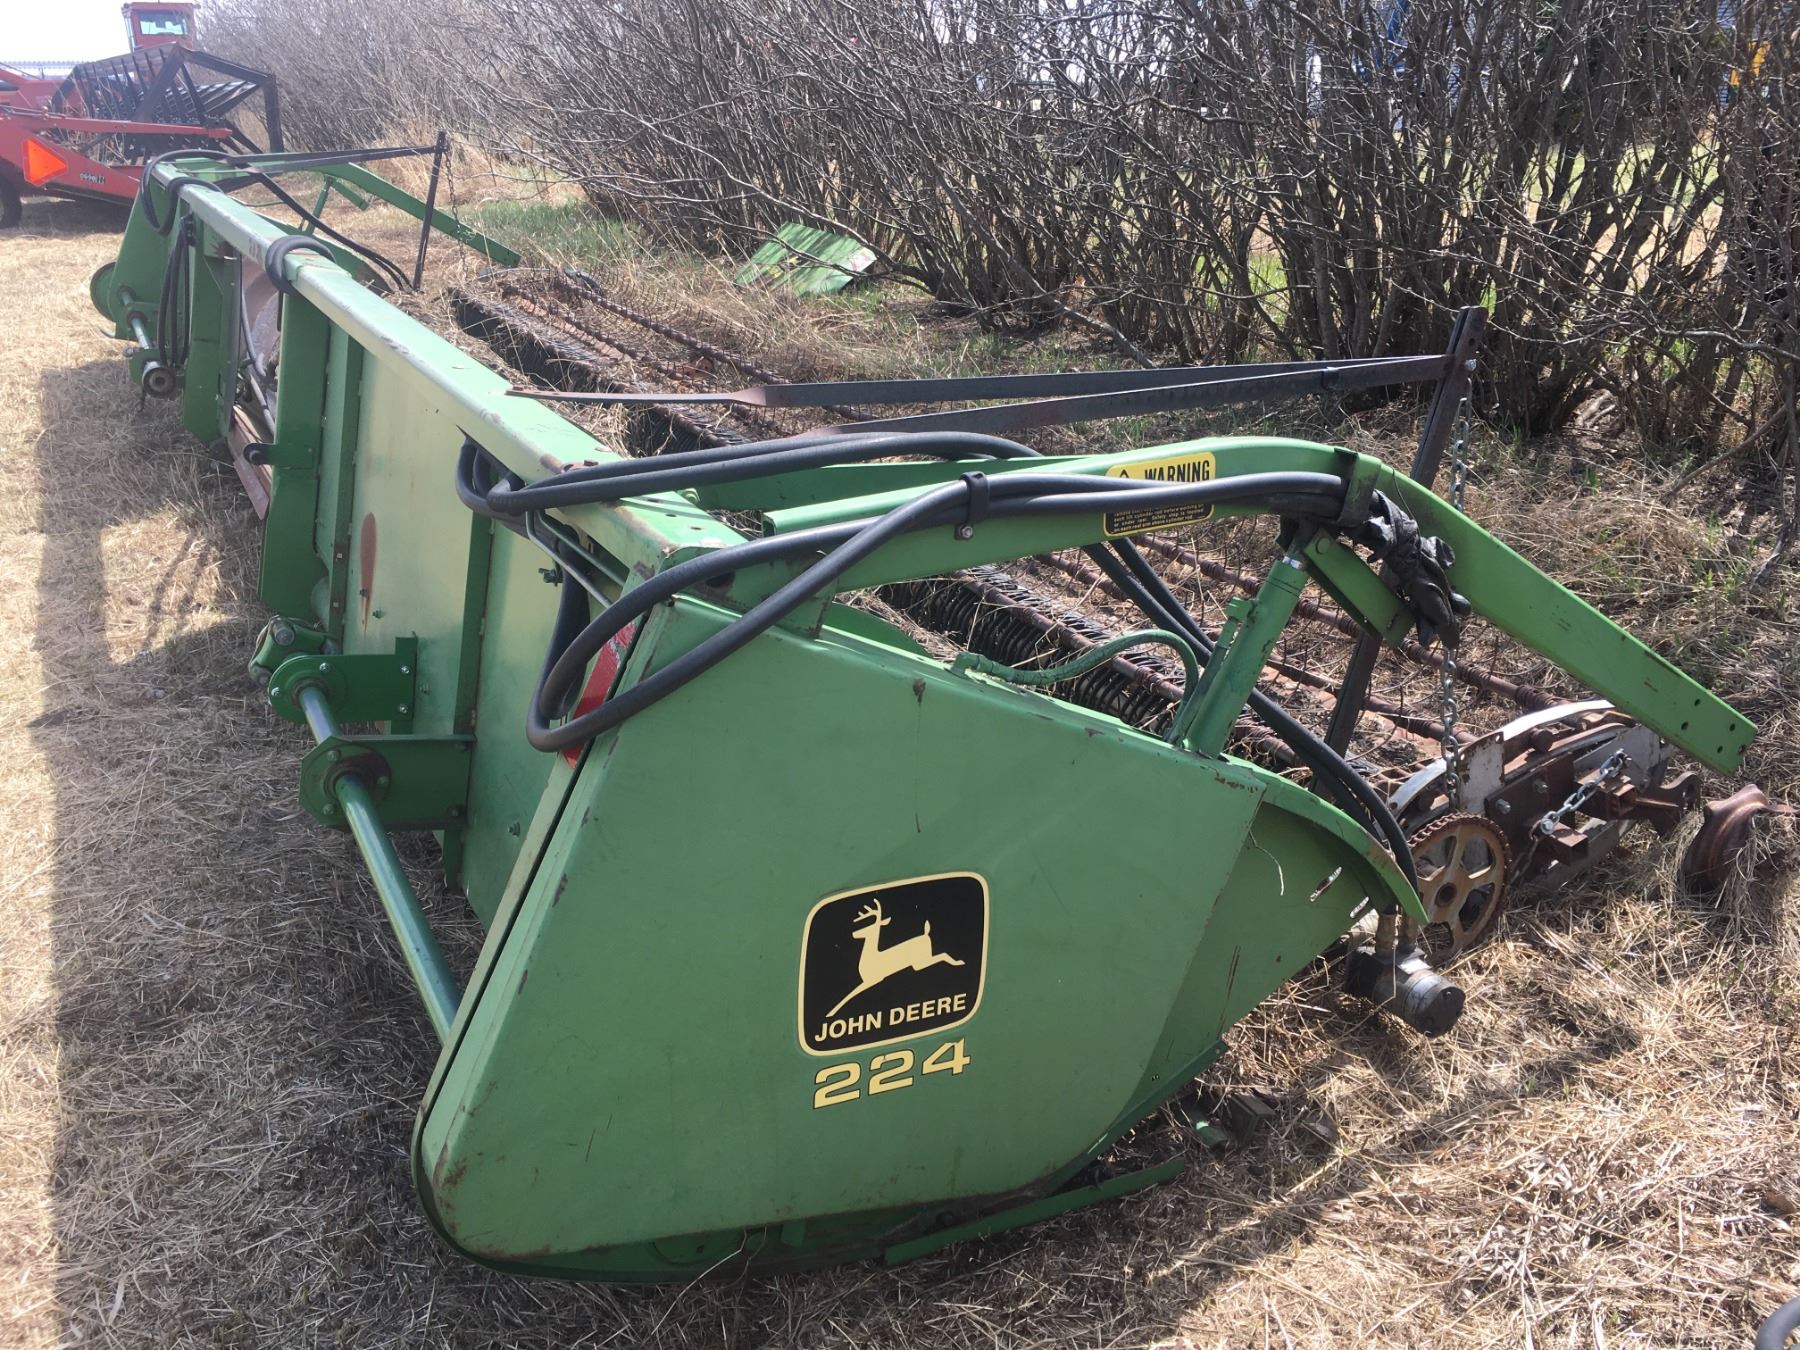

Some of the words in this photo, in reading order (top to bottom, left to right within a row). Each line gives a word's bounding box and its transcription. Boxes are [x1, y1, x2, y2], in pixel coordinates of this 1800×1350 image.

[1145, 460, 1210, 483] WARNING
[814, 1011, 882, 1042] JOHN
[889, 993, 967, 1025] DEERE
[813, 1038, 971, 1109] 224
